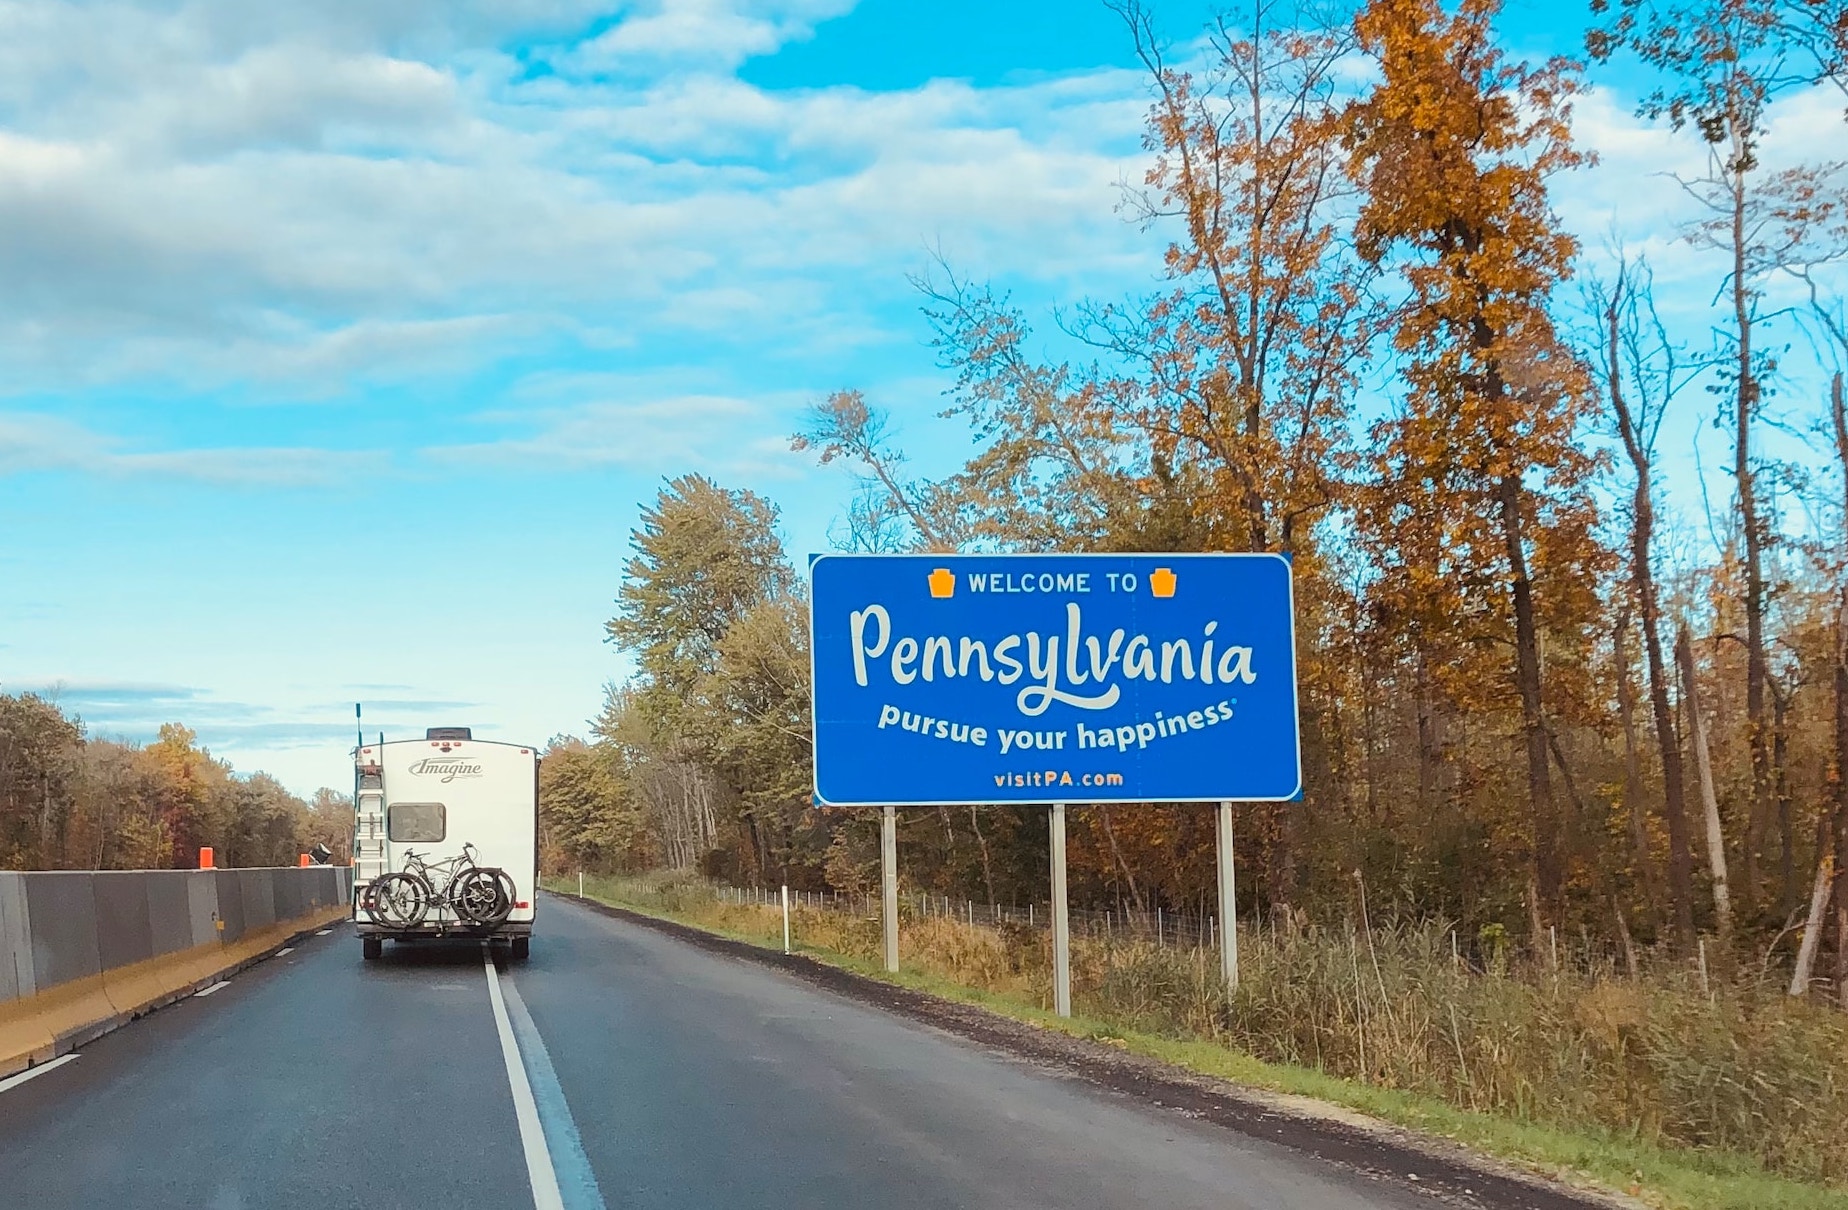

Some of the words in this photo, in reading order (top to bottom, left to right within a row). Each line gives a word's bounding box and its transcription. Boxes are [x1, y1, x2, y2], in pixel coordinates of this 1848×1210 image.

[968, 573, 1091, 593] WELCOME
[1106, 573, 1138, 593] TO
[850, 602, 1258, 717] Pennsylvania
[878, 703, 988, 747] pursue
[998, 728, 1067, 754] your
[1077, 700, 1234, 753] happiness
[416, 757, 483, 784] Imagine
[994, 770, 1124, 788] visitPA.com
